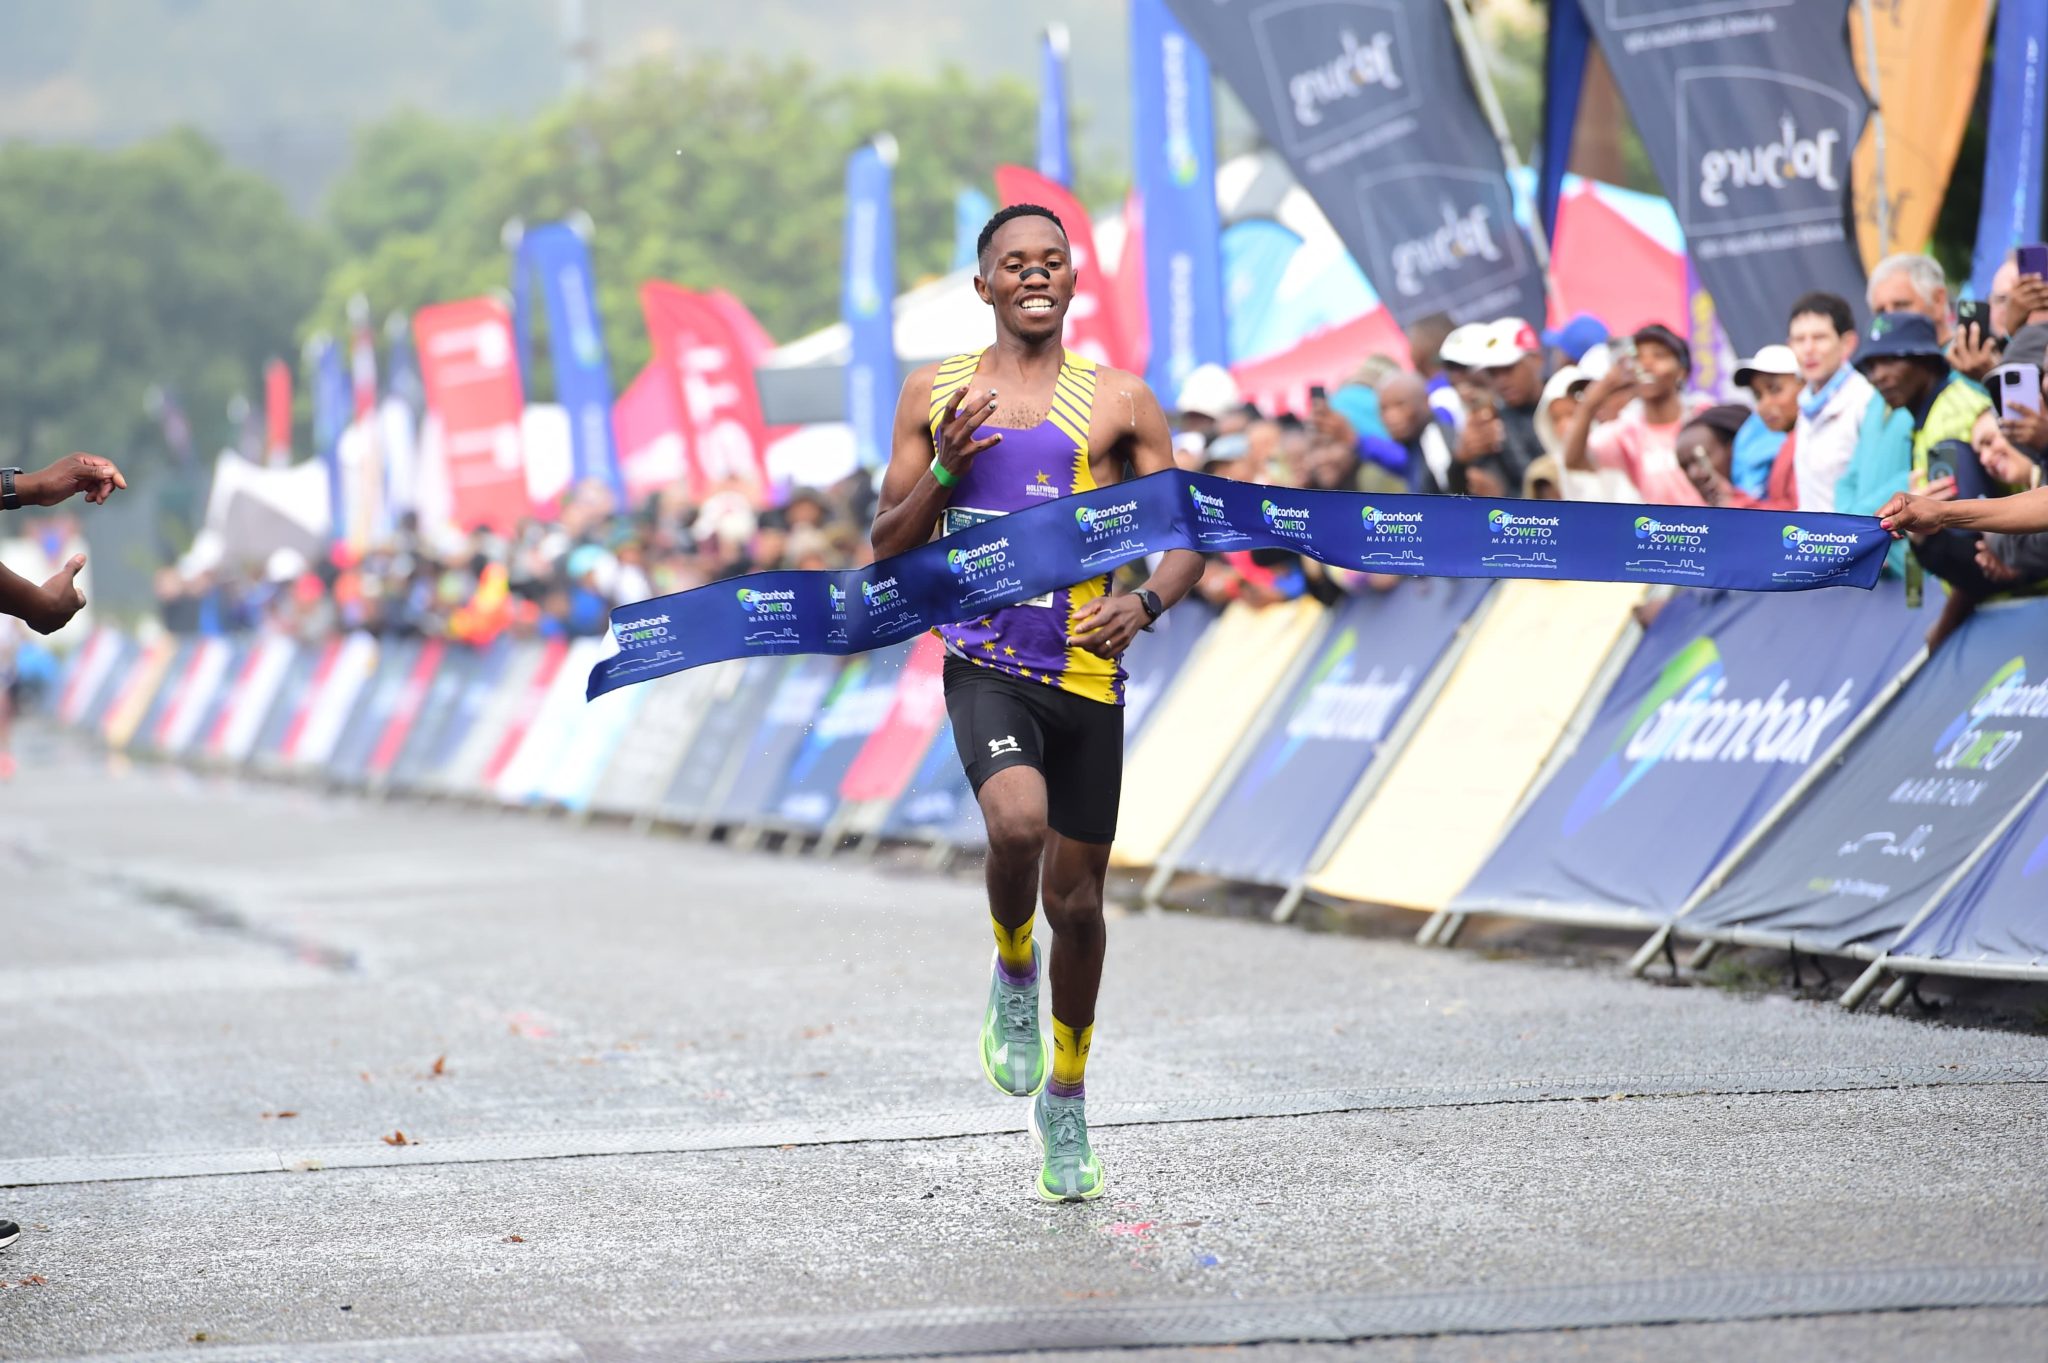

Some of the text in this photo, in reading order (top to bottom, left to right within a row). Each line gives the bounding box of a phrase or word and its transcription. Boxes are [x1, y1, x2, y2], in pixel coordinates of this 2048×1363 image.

[1025, 484, 1059, 495] HOLLYWOOD
[1082, 500, 1138, 523] africanbank
[1200, 504, 1225, 519] SOWETO
[1266, 505, 1310, 519] africanbank
[1367, 511, 1424, 522] africanbank
[1092, 514, 1133, 533] SOWETO
[1273, 519, 1306, 531] SOWETO
[1494, 514, 1560, 526] africanbank
[1086, 523, 1139, 544] MARATHON
[1270, 529, 1313, 540] MARATHON
[1375, 524, 1418, 535] SOWETO
[1503, 526, 1553, 538] SOWETO
[1641, 521, 1710, 535] africanbank
[1366, 535, 1423, 543] MARATHON
[1491, 537, 1558, 546] MARATHON
[1649, 533, 1702, 546] SOWETO
[1788, 531, 1859, 544] africanbank
[953, 537, 1010, 564] africanbank
[1637, 543, 1707, 554] MARATHON
[1797, 543, 1850, 556] SOWETO
[964, 551, 1006, 574] SOWETO
[1784, 554, 1855, 564] MARATHON
[958, 560, 1016, 585] MARATHON
[871, 589, 899, 607] SOWETO
[756, 602, 793, 614] SOWETO
[869, 598, 908, 616] MARATHON
[748, 613, 798, 622] MARATHON
[616, 626, 668, 644] SOWETO
[619, 635, 678, 652] ARATHON
